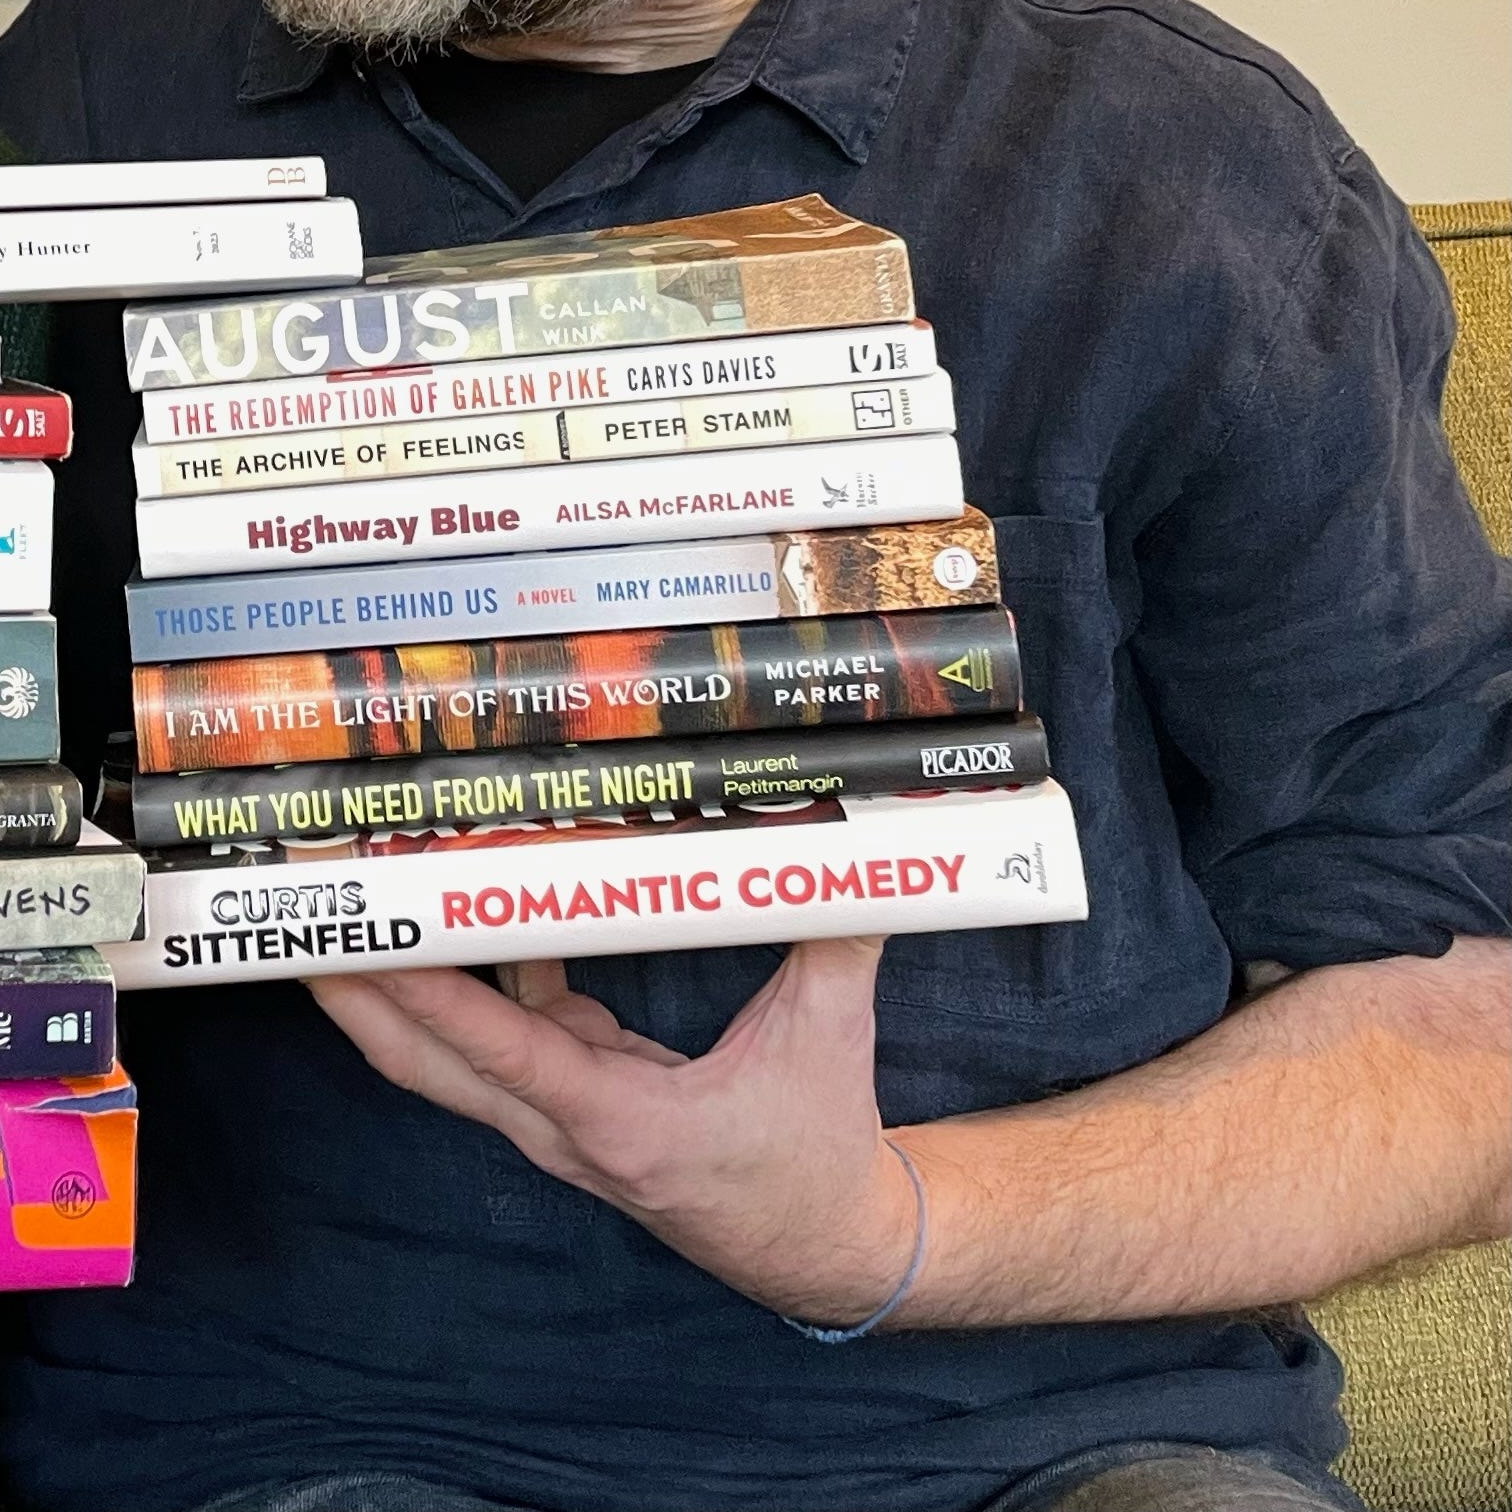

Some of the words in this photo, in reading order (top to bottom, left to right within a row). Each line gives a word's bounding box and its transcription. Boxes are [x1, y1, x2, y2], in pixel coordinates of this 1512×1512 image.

[17, 239, 92, 257] Hunter
[539, 294, 647, 320] CALLAN
[128, 281, 529, 390] AUGUST
[541, 325, 603, 346] WINK
[168, 402, 217, 436] THE
[229, 386, 397, 431] REDEMPTION
[409, 382, 438, 414] OF
[452, 373, 536, 410] GALEN
[548, 366, 609, 401] PIKE
[627, 362, 694, 392] CARYS
[703, 355, 777, 385] DAVIES
[899, 387, 913, 426] OTHER
[176, 457, 223, 480] THE
[236, 446, 345, 476] ARCHIVE
[357, 442, 387, 464] OF
[403, 430, 525, 461] FEELINGS
[604, 415, 687, 442] PETER
[703, 406, 793, 434] STAMM
[247, 514, 419, 555] Highway
[430, 503, 520, 537] Blue
[555, 498, 632, 524] AILSA
[639, 487, 795, 517] McFARLANE
[154, 605, 237, 638] THOSE
[246, 597, 346, 630] PEOPLE
[355, 589, 454, 622] BEHIND
[465, 586, 499, 615] US
[516, 590, 527, 606] A
[531, 586, 577, 605] NOVEL
[596, 578, 652, 602] MARY
[659, 570, 772, 599] CAMARILLO
[764, 654, 885, 680] MICHAEL
[165, 710, 177, 738] I
[189, 707, 239, 736] AM
[250, 702, 321, 732] THE
[333, 692, 436, 727] LIGHT
[448, 688, 497, 719] OF
[507, 681, 592, 714] THIS
[602, 673, 733, 708] WORLD
[774, 682, 881, 706] PARKER
[720, 753, 799, 776] Laurent
[920, 744, 1015, 777] PICADOR
[174, 794, 261, 839] WHAT
[268, 788, 333, 831] YOU
[342, 781, 424, 827] NEED
[433, 774, 524, 819] FROM
[530, 768, 592, 811] THE
[599, 760, 696, 806] NIGHT
[723, 774, 844, 797] Petitmangin
[209, 879, 368, 926] CURTIS
[441, 871, 722, 929] ROMANTIC
[736, 853, 967, 909] COMEDY
[163, 917, 422, 969] SITTENFELD
